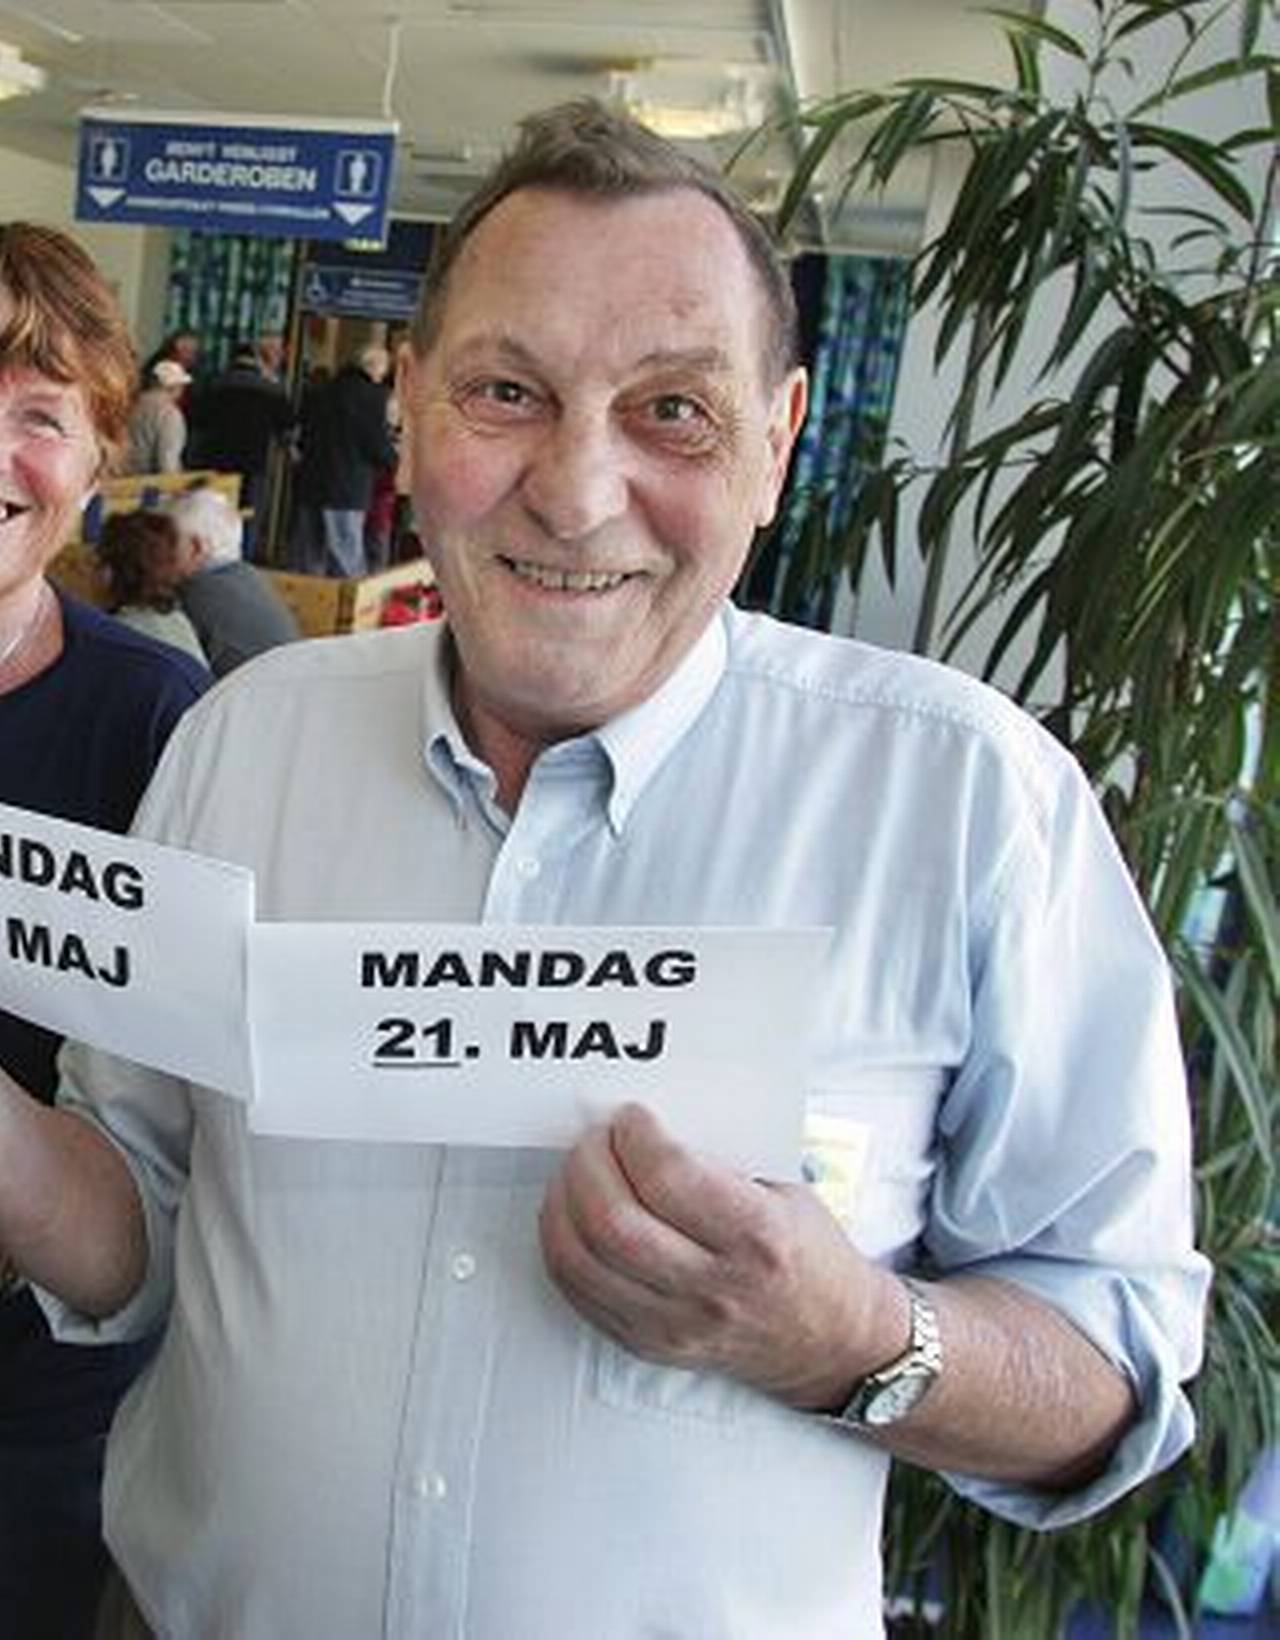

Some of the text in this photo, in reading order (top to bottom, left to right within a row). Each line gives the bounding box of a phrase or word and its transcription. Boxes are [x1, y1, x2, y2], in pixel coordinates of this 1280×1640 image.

[144, 156, 318, 192] GARDEROBEN
[5, 916, 131, 989] MAJ
[360, 950, 698, 989] MANDAG
[374, 1017, 668, 1066] 21. MAJ
